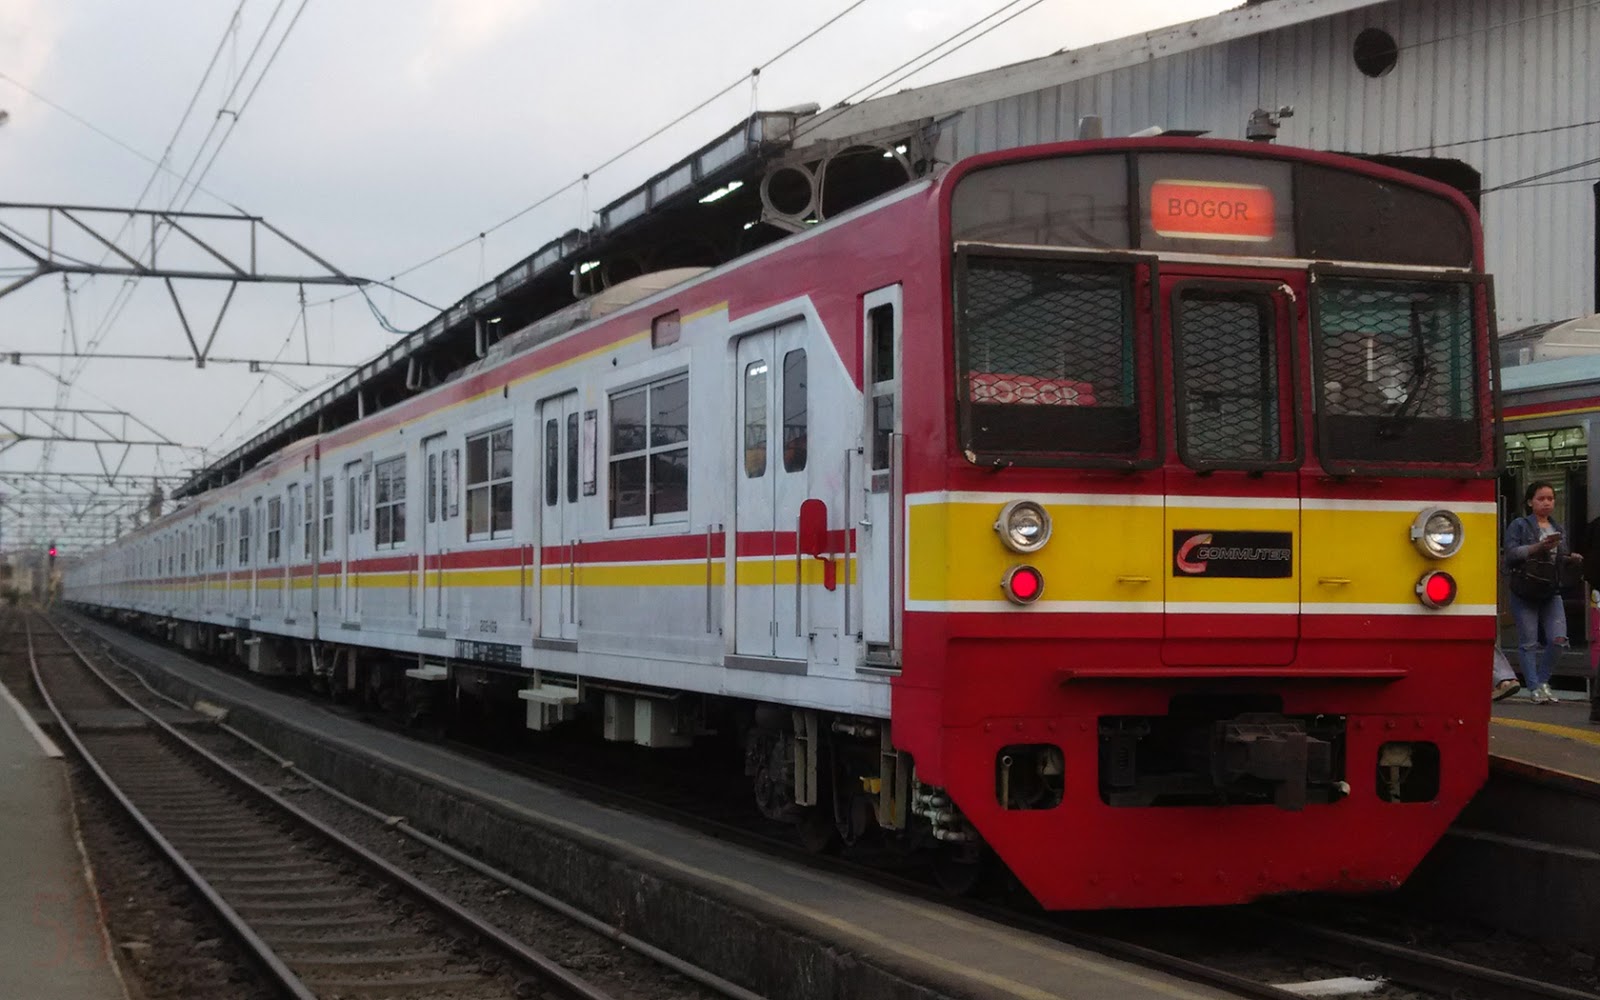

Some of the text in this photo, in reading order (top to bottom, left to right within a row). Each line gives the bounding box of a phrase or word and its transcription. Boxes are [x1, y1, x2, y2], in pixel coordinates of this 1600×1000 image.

[1168, 198, 1248, 220] BOGOR
[973, 378, 1080, 406] BOGOR
[1197, 546, 1290, 561] COMMUTER
